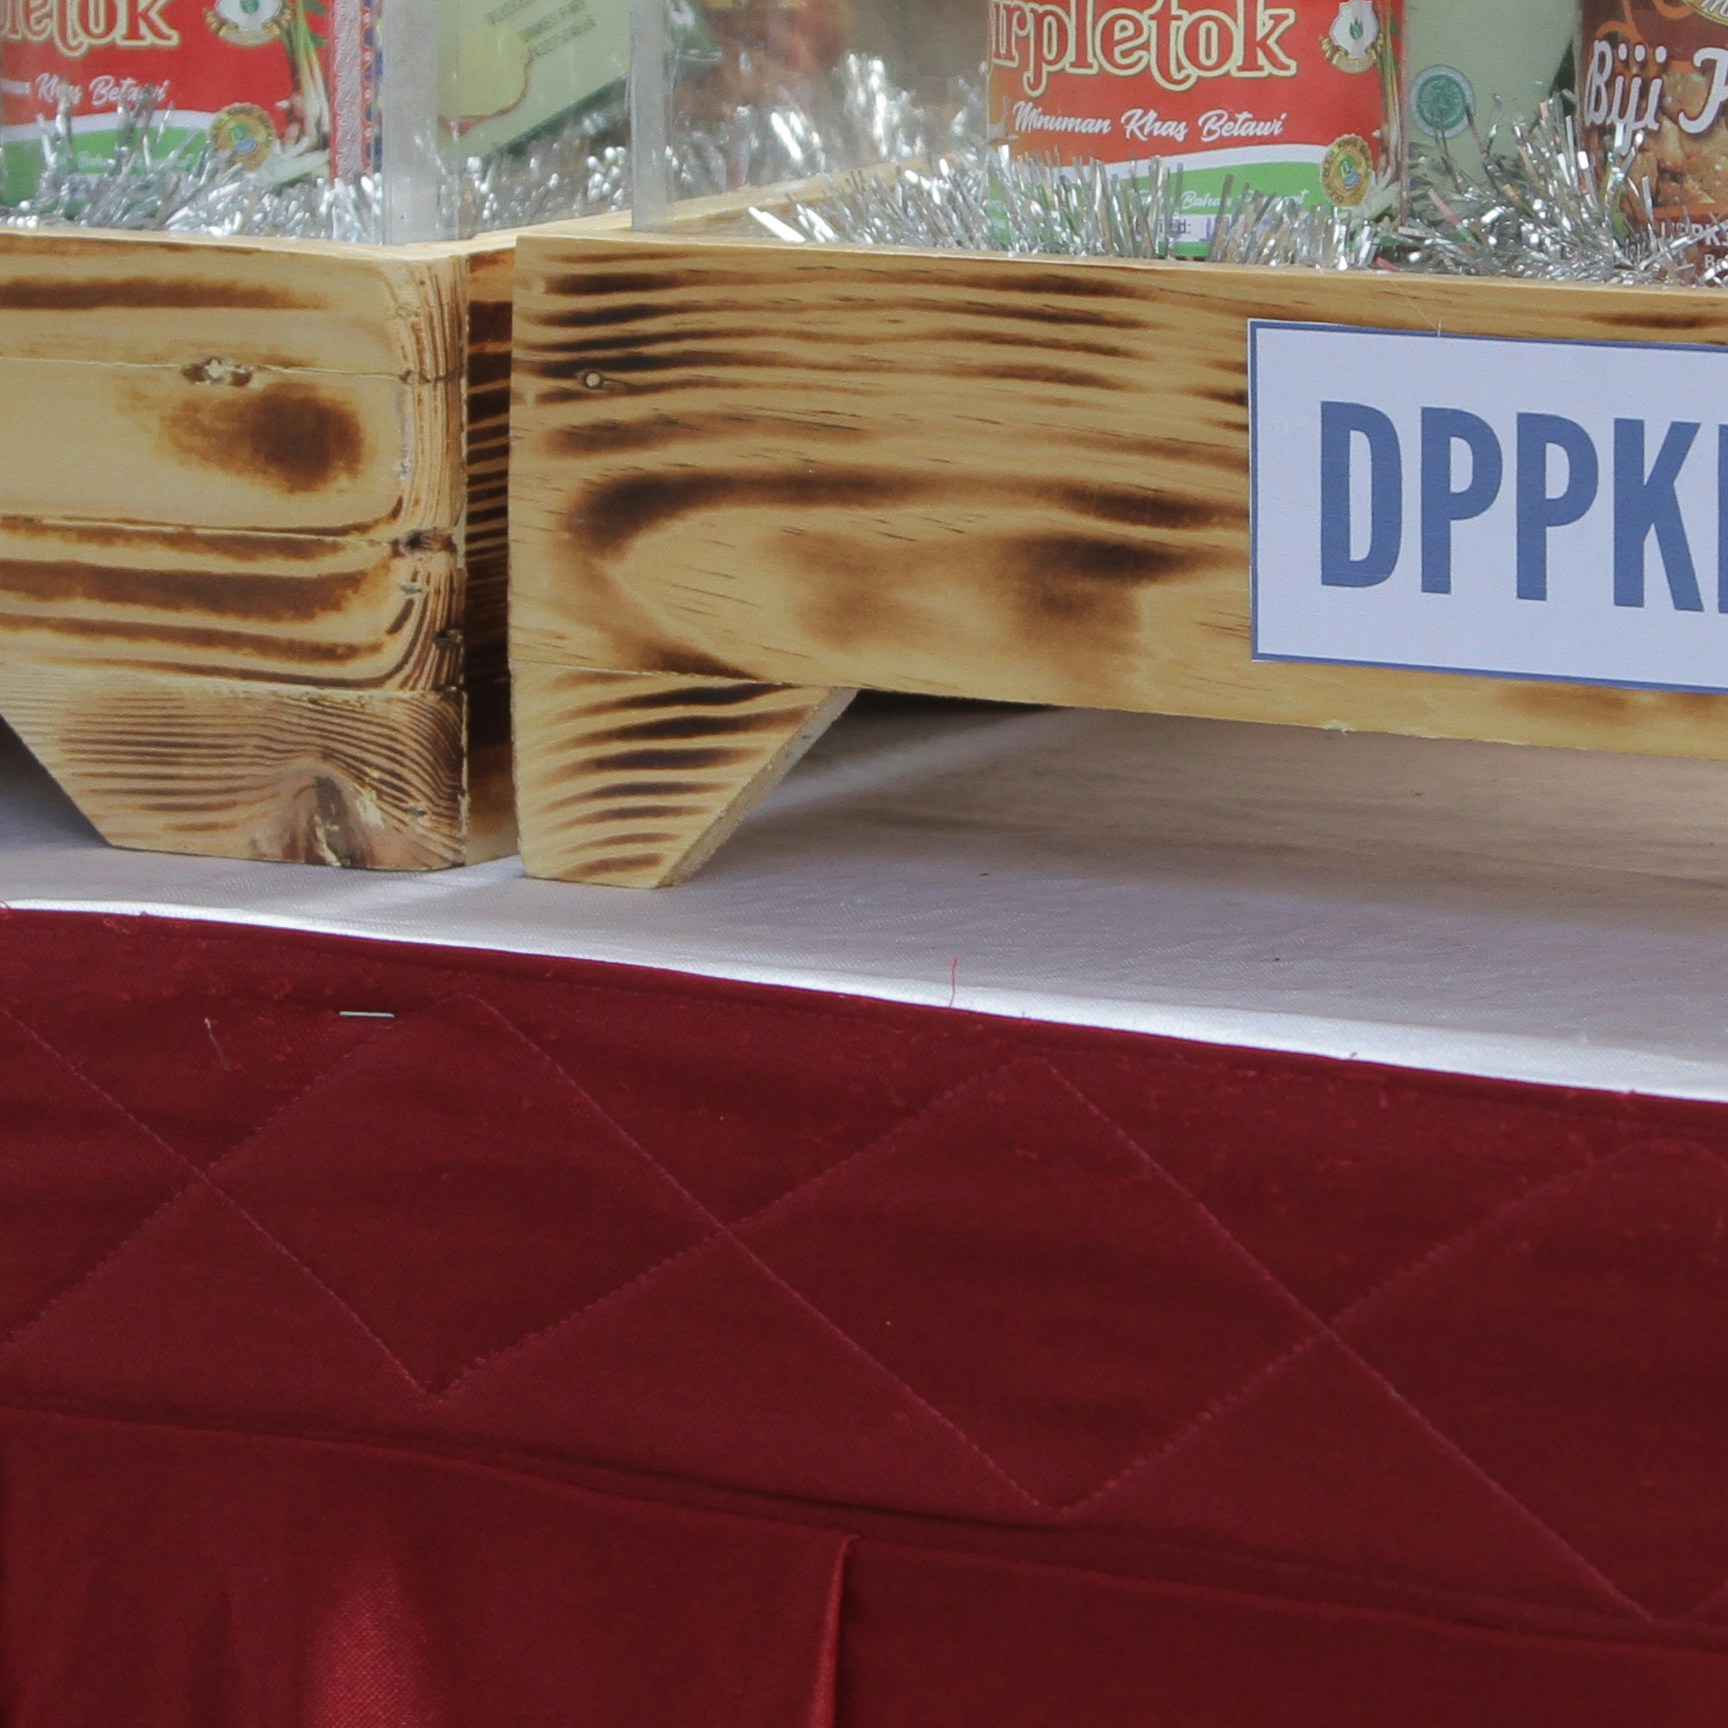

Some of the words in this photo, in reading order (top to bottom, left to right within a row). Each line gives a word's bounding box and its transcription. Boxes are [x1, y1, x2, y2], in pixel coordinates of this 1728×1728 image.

[1011, 99, 1113, 136] Minuman
[1121, 107, 1190, 144] Khas
[1198, 109, 1289, 145] Betawi
[1585, 39, 1667, 156] Biji
